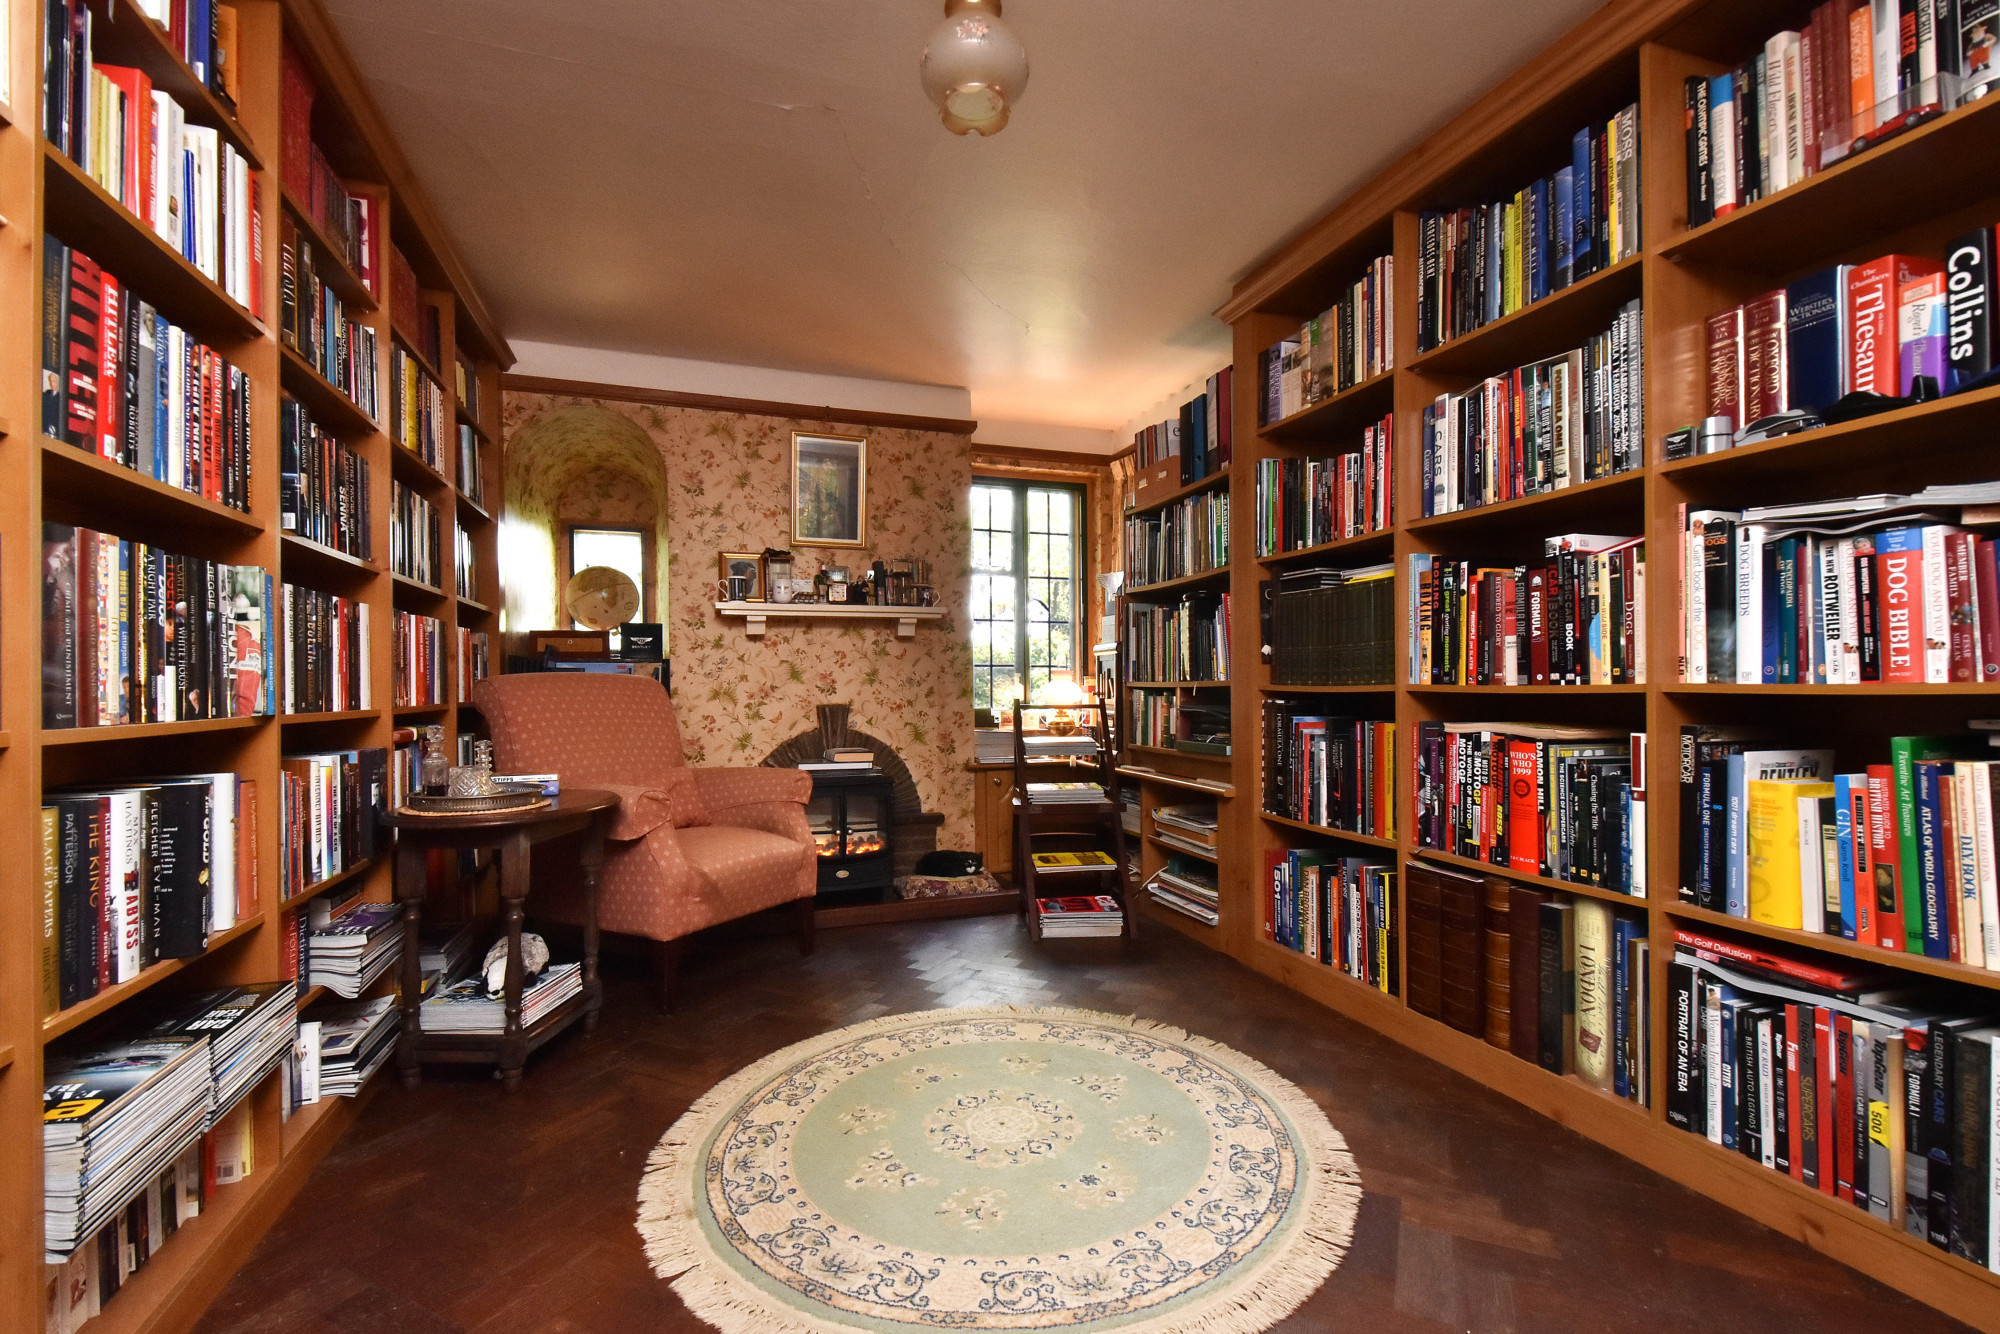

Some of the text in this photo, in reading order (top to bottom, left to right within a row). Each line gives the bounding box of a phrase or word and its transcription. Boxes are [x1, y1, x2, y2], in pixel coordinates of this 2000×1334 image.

[1901, 12, 1915, 59] HITLER
[1767, 60, 1781, 133] Wild Flowers
[1621, 111, 1633, 161] MOSS
[1556, 203, 1566, 257] Mercedes
[1575, 173, 1585, 242] Mercedes
[1850, 272, 1890, 289] Chambers
[1862, 268, 1876, 277] The
[1948, 245, 1985, 362] Collins
[68, 249, 100, 440] HITLER
[106, 284, 118, 378] HITLER
[156, 323, 165, 363] NATION
[1630, 360, 1638, 404] YEARBOOK
[1724, 353, 1736, 405] OXFORD
[1766, 338, 1780, 393] OXFORD
[128, 405, 136, 450] ROBERTS
[1555, 368, 1563, 448] FORMULA ONE
[339, 485, 348, 532] SENNA
[147, 565, 156, 595] RIGHT
[1739, 544, 1750, 616] DOG BREEDS
[1785, 559, 1793, 608] ENCYCLOPAEDIA
[1927, 530, 1943, 637] YOUR DOG AND YOU
[1958, 544, 1968, 581] MEMBER
[148, 599, 156, 620] PAIR
[207, 566, 215, 609] REGGIE
[1420, 583, 1431, 631] BOXING
[1516, 583, 1525, 636] FORMULA ONE
[1548, 570, 1559, 639] CAR BOOK
[1824, 546, 1841, 641] THE NEW ROTTWEILER
[1496, 613, 1501, 622] TO
[1531, 591, 1540, 637] FORMULA
[1625, 601, 1634, 635] DOGS
[1887, 558, 1910, 668] DOG BIBLE
[1566, 624, 1574, 650] BOOK
[1952, 632, 1961, 661] MILLAN
[1962, 634, 1971, 658] CESAR
[178, 660, 186, 691] HOUSE
[1510, 752, 1536, 760] WHO'S
[1511, 760, 1532, 768] WHO
[1681, 734, 1692, 783] MOTORCAR
[1467, 785, 1472, 795] OF
[1473, 758, 1481, 804] MOTOGP
[1731, 796, 1739, 810] 1001
[1881, 778, 1889, 810] ILLUSTRATED
[1898, 750, 1912, 837] Florentine Art Treasures
[1868, 778, 1884, 850] BRITISH HISTORY
[1884, 831, 1892, 839] TO
[1922, 806, 1932, 834] ATLAS
[65, 813, 73, 883] PATTERSON
[89, 814, 99, 907] THE KING
[1837, 809, 1850, 882] GIN Aaron Knoll
[1923, 836, 1932, 848] OF
[1924, 850, 1935, 880] WORLD
[44, 818, 53, 938] PALACE PAPERS
[126, 896, 139, 950] ABYSS
[1926, 882, 1938, 940] GEOGRAPHY
[1540, 928, 1559, 993] Biblica
[1677, 932, 1752, 961] The Golf Delusion
[1579, 944, 1596, 1019] LONDON
[1678, 990, 1688, 1092] PORTRAIT OF AN ERA
[1815, 1023, 1828, 1031] evo
[1708, 1014, 1718, 1121] Wogan's Ireland Terry Wogan
[1745, 1036, 1754, 1066] BRITISH
[1761, 1040, 1769, 1079] RAC RALLY
[1838, 1029, 1849, 1077] TopGear
[1722, 1063, 1731, 1088] CITIES
[1746, 1068, 1755, 1091] AUTO
[1871, 1039, 1887, 1133] TopGear 500
[1933, 1030, 1945, 1123] LEGENDARY CARS
[1747, 1093, 1756, 1129] LEGENDS
[1800, 1076, 1814, 1140] SUPERCARS
[1856, 1097, 1866, 1115] CARS
